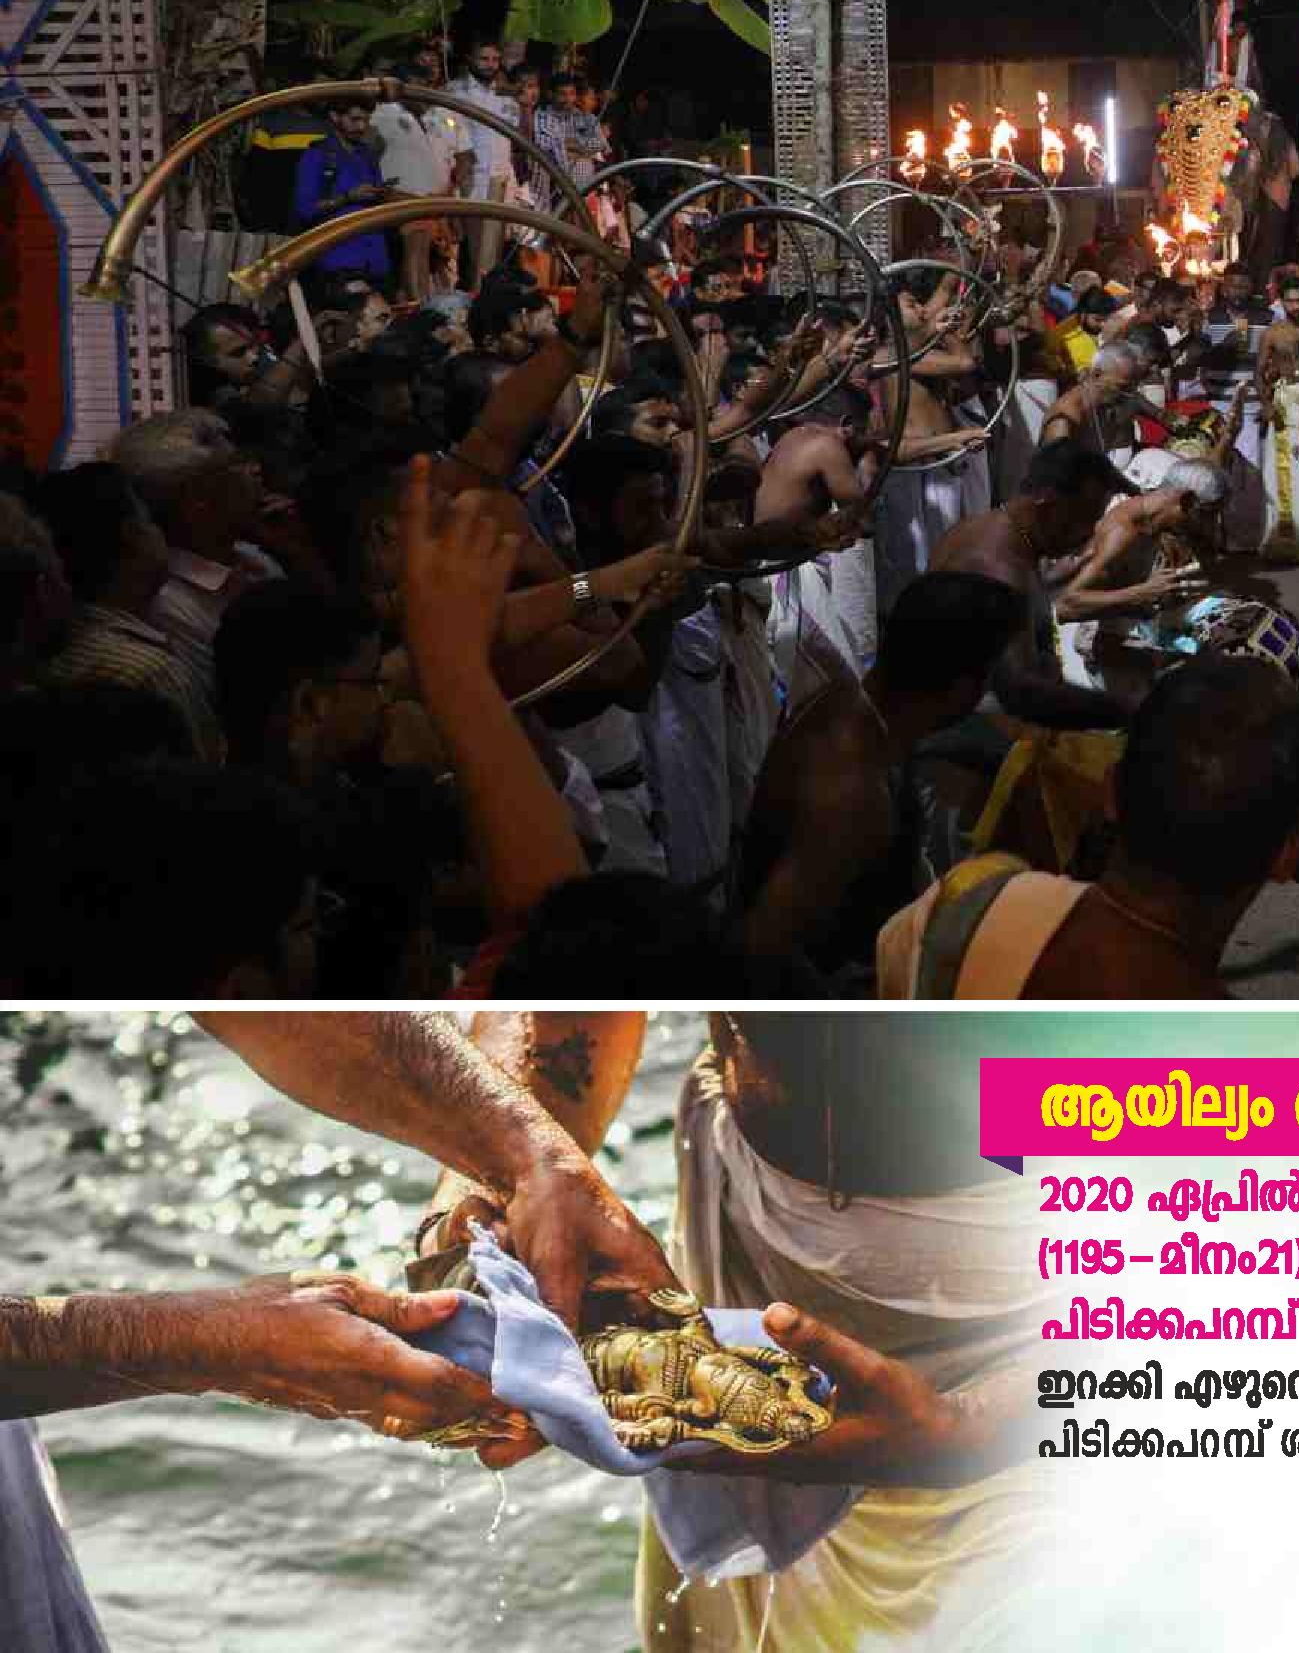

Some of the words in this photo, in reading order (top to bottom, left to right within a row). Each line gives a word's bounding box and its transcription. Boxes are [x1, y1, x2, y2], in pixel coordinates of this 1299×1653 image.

[1041, 1070, 1274, 1141] ആയില്യം
[1040, 1176, 1133, 1212] 2020
[1038, 1360, 1162, 1408] ഇറക്കി
[1039, 1419, 1273, 1458] പിടിക്കപറമ്പ്
